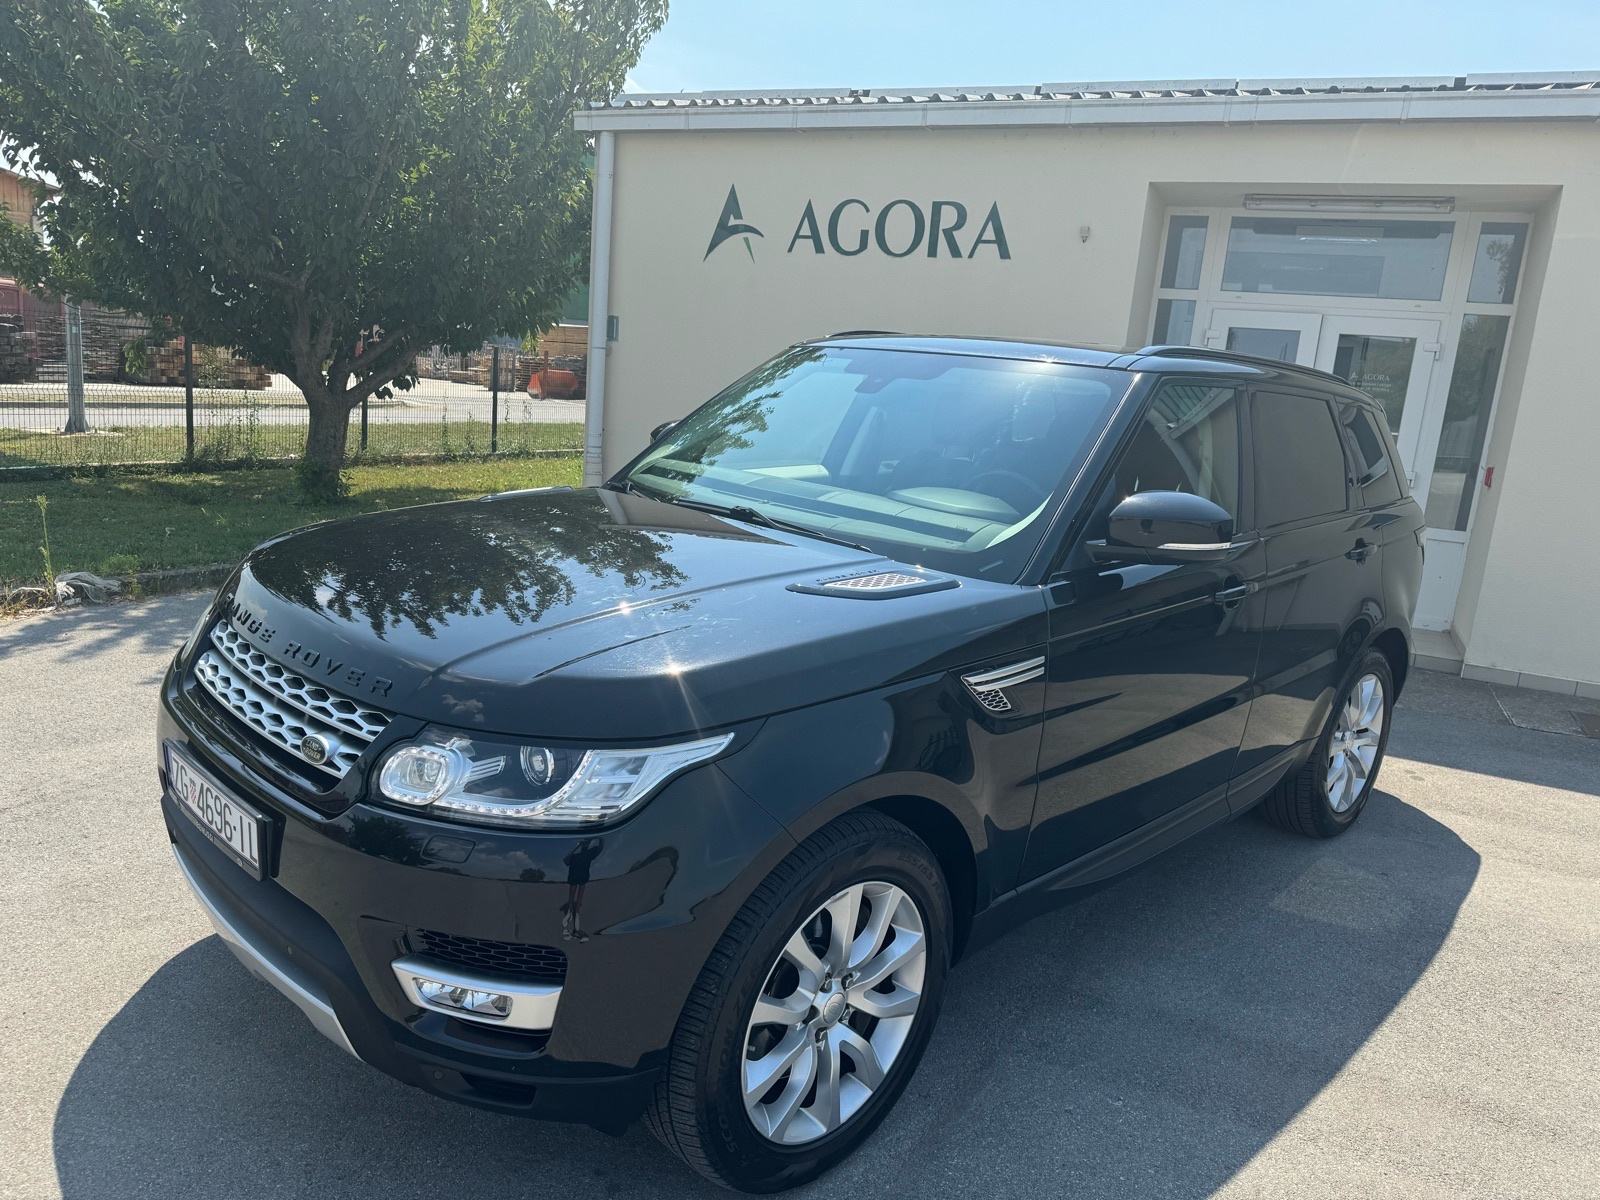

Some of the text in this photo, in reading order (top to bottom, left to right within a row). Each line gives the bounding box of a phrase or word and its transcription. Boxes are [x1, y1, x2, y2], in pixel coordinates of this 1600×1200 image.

[787, 198, 1011, 260] AGORA
[284, 640, 393, 698] ROVER
[172, 758, 189, 801] ZG
